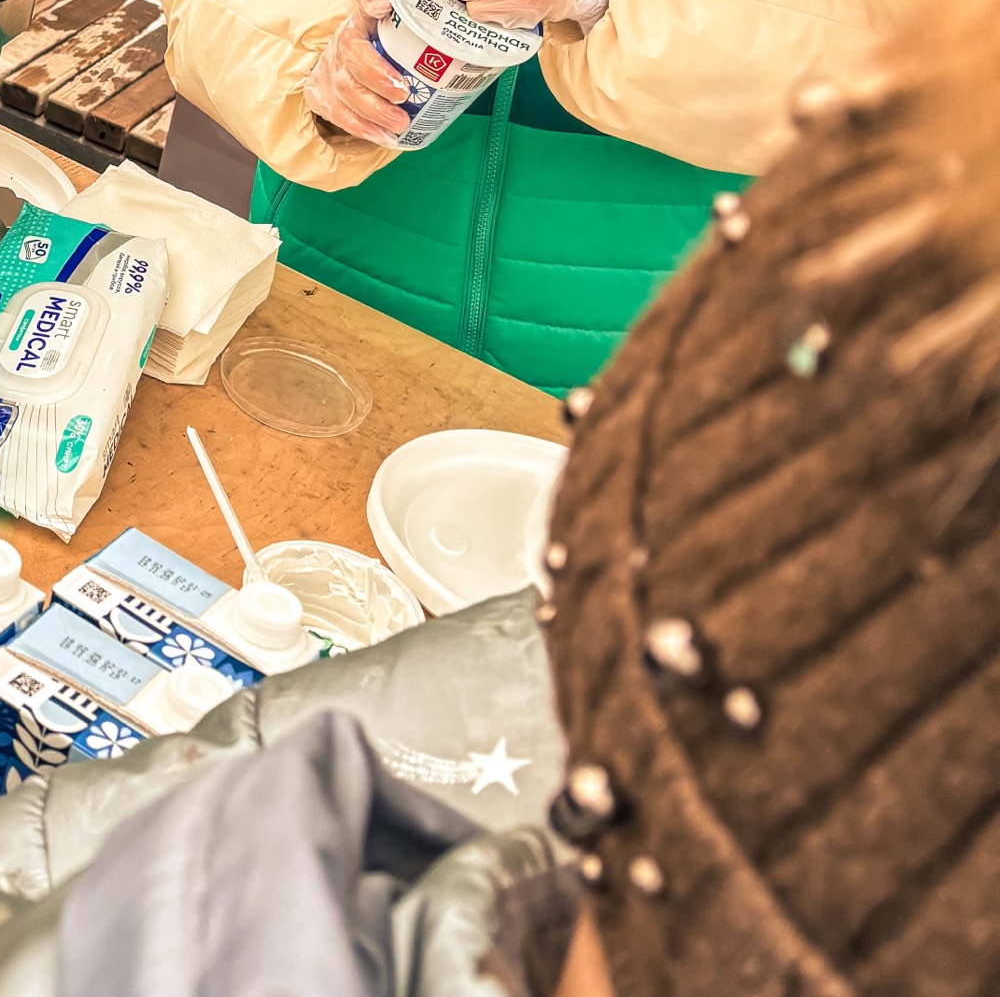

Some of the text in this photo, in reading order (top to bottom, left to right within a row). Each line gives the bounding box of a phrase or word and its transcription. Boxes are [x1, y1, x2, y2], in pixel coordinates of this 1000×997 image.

[445, 19, 510, 53] долина
[449, 8, 531, 52] северная
[37, 241, 49, 257] 50
[124, 258, 149, 294] 99,9%
[16, 296, 67, 372] MEDICAL
[54, 299, 82, 341] smart
